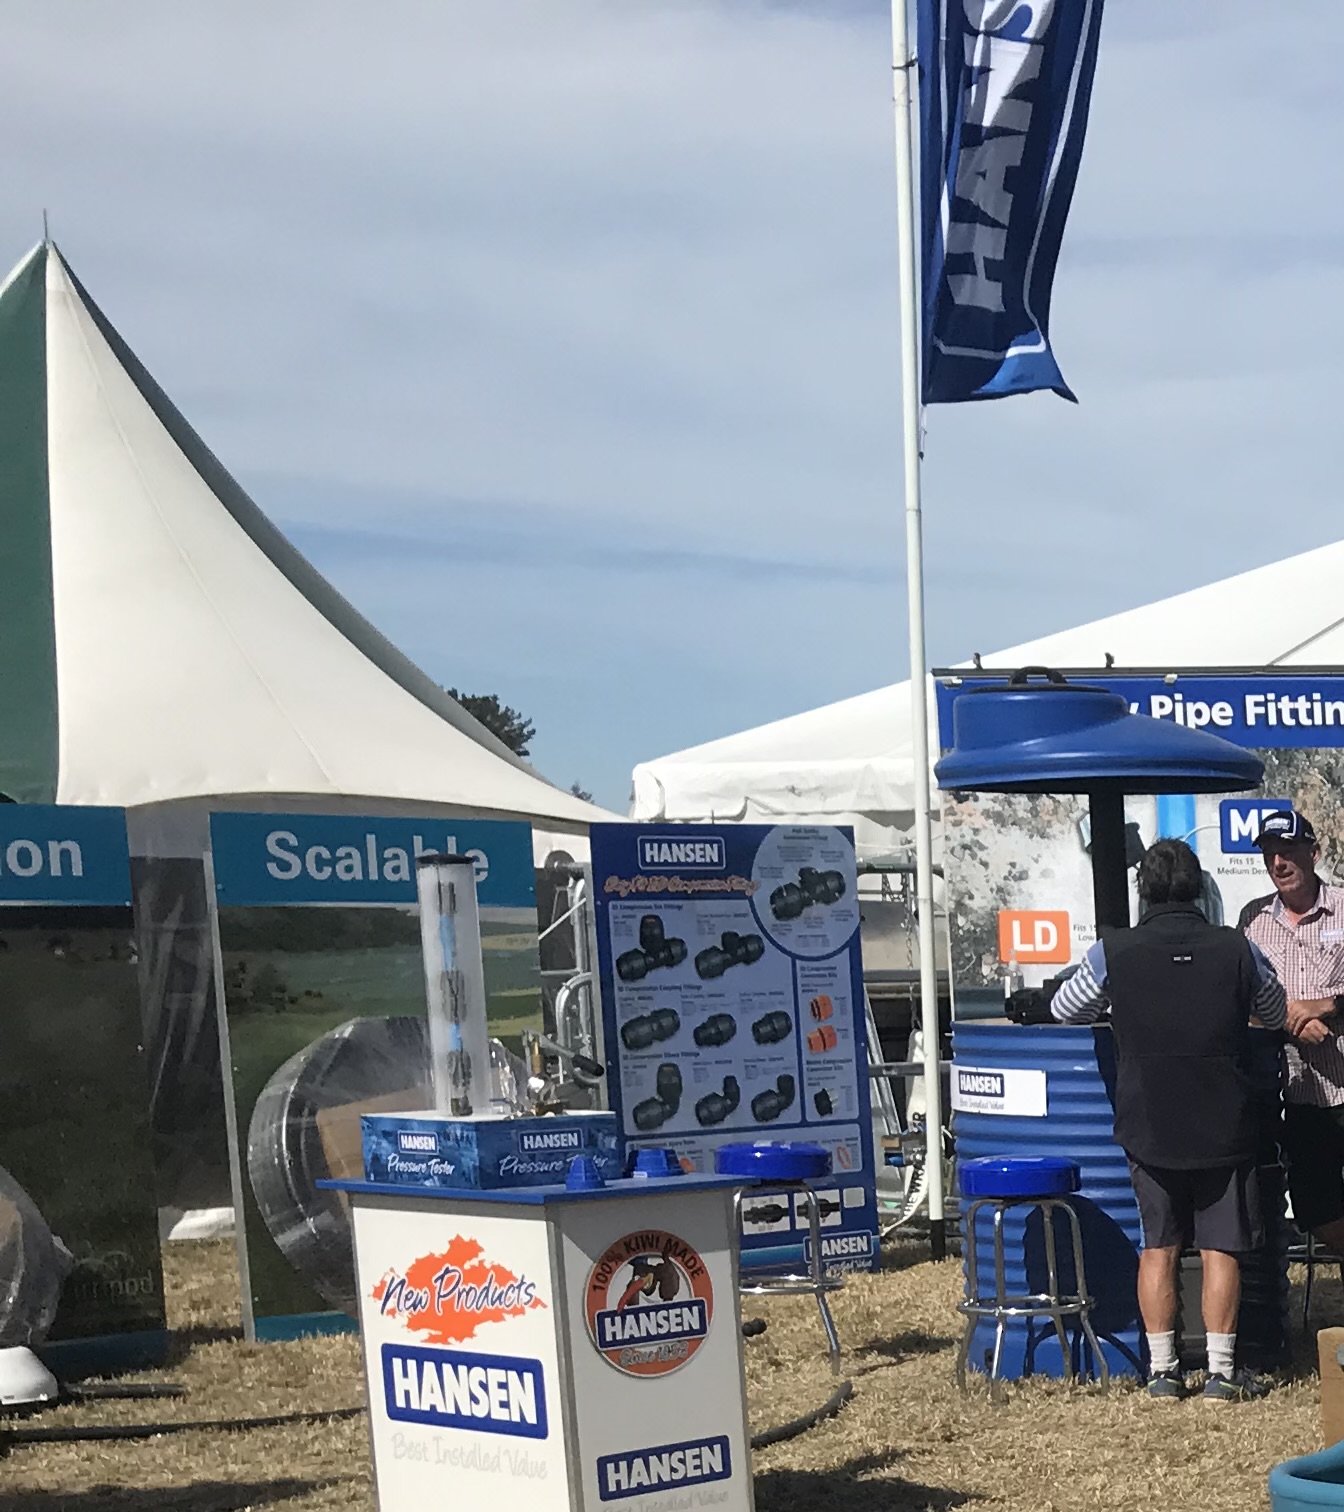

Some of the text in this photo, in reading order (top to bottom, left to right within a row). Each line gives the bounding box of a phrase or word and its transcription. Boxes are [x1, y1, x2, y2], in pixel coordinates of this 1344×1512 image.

[1150, 692, 1233, 730] Pipe
[1229, 808, 1278, 841] M
[0, 838, 83, 878] on
[645, 843, 719, 863] HANSEN
[1230, 857, 1243, 865] Fits
[1217, 867, 1249, 875] Medium
[1012, 920, 1057, 953] LD
[1073, 924, 1087, 933] Fits
[959, 1074, 1003, 1095] HANSEN
[401, 1135, 436, 1150] HANSEN
[523, 1133, 578, 1149] HANSEN
[387, 1153, 455, 1175] Pressure Tester
[499, 1155, 563, 1177] Pressure
[592, 1233, 704, 1292] 100% KIWI MADE
[381, 1266, 537, 1316] New Products
[604, 1306, 700, 1342] HANSEN
[391, 1357, 538, 1425] HANSEN
[391, 1431, 549, 1480] Best Installed Value
[606, 1443, 724, 1493] HANSEN
